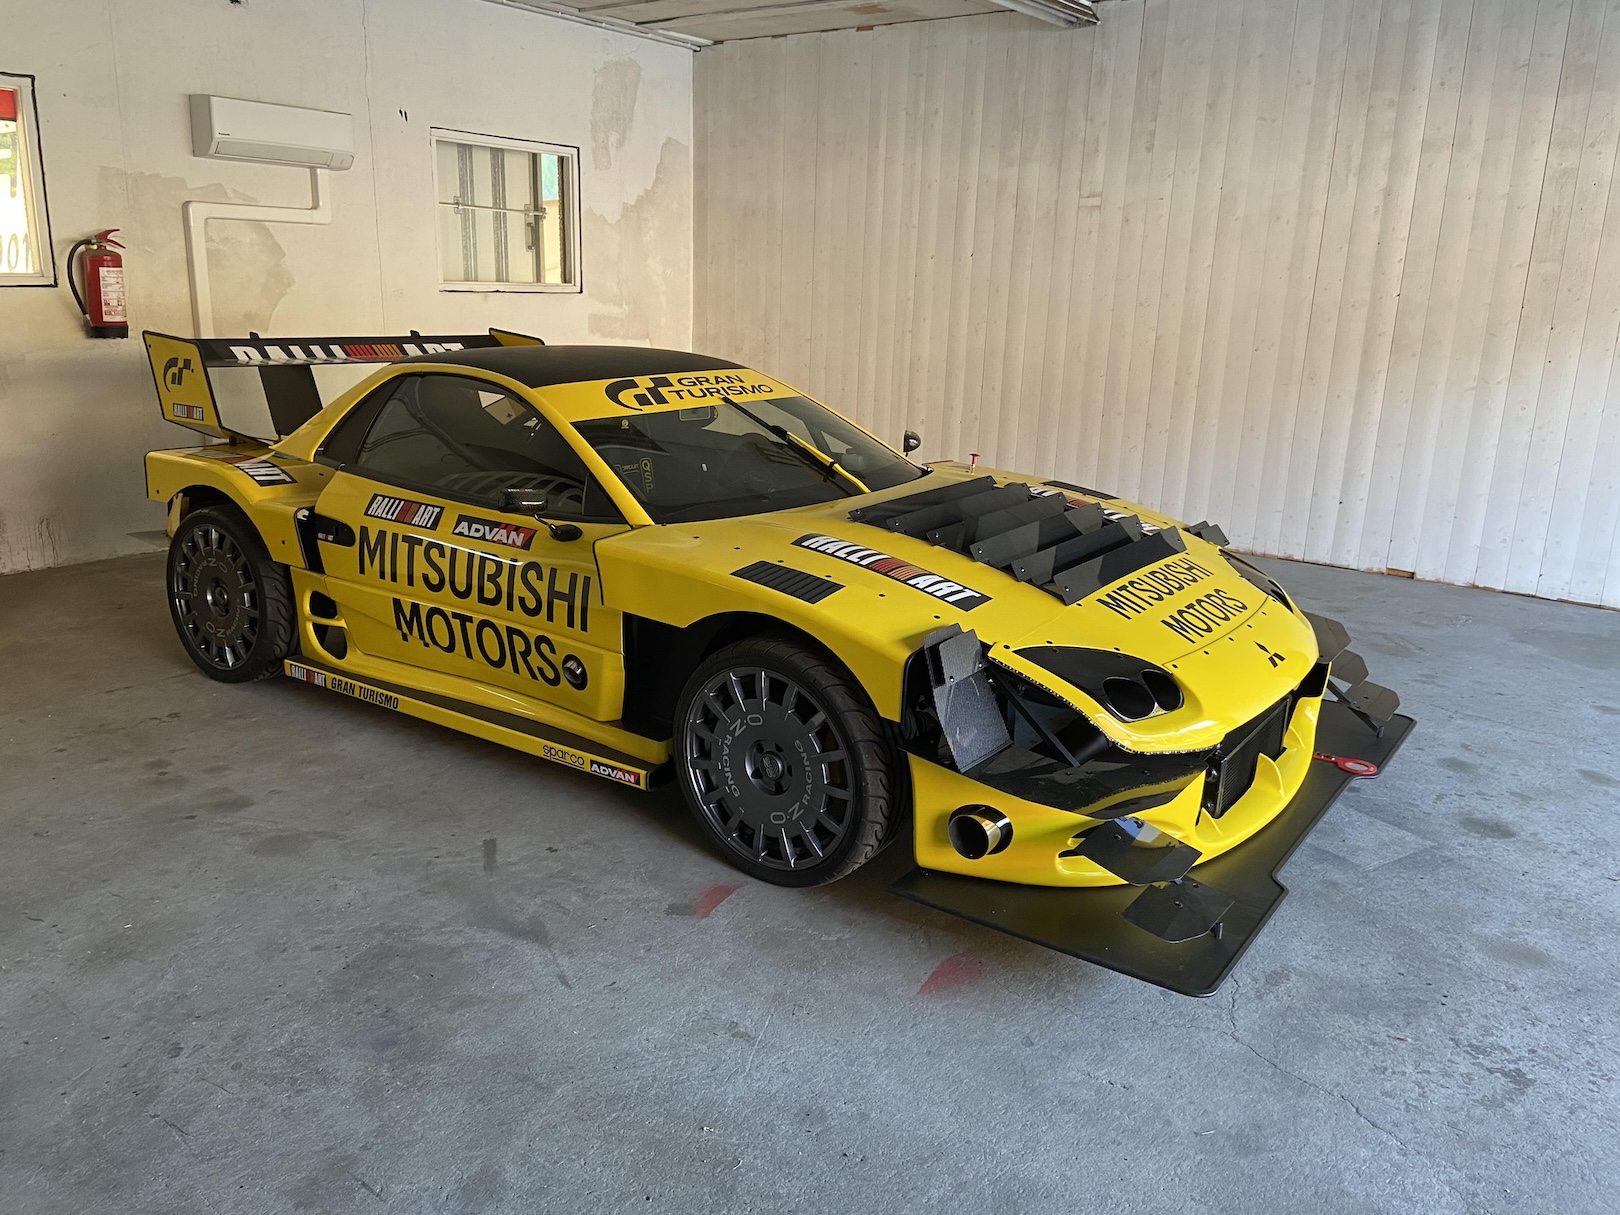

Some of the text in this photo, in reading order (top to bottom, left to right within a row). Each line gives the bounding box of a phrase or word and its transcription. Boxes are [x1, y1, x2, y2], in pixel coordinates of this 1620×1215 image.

[668, 384, 774, 401] TURISMO
[676, 374, 746, 388] GRAN
[453, 521, 525, 547] ADVAN
[358, 526, 592, 633] MITSUBISHI
[1096, 557, 1215, 621] MITSUBISHI
[1160, 588, 1248, 645] MOTORS
[392, 597, 561, 687] MOTORS
[330, 677, 400, 710] GRAN TURISMO
[542, 744, 585, 768] sparco
[591, 763, 636, 784] ADVAN
[721, 733, 741, 798] RACING
[794, 739, 813, 805] RACING
